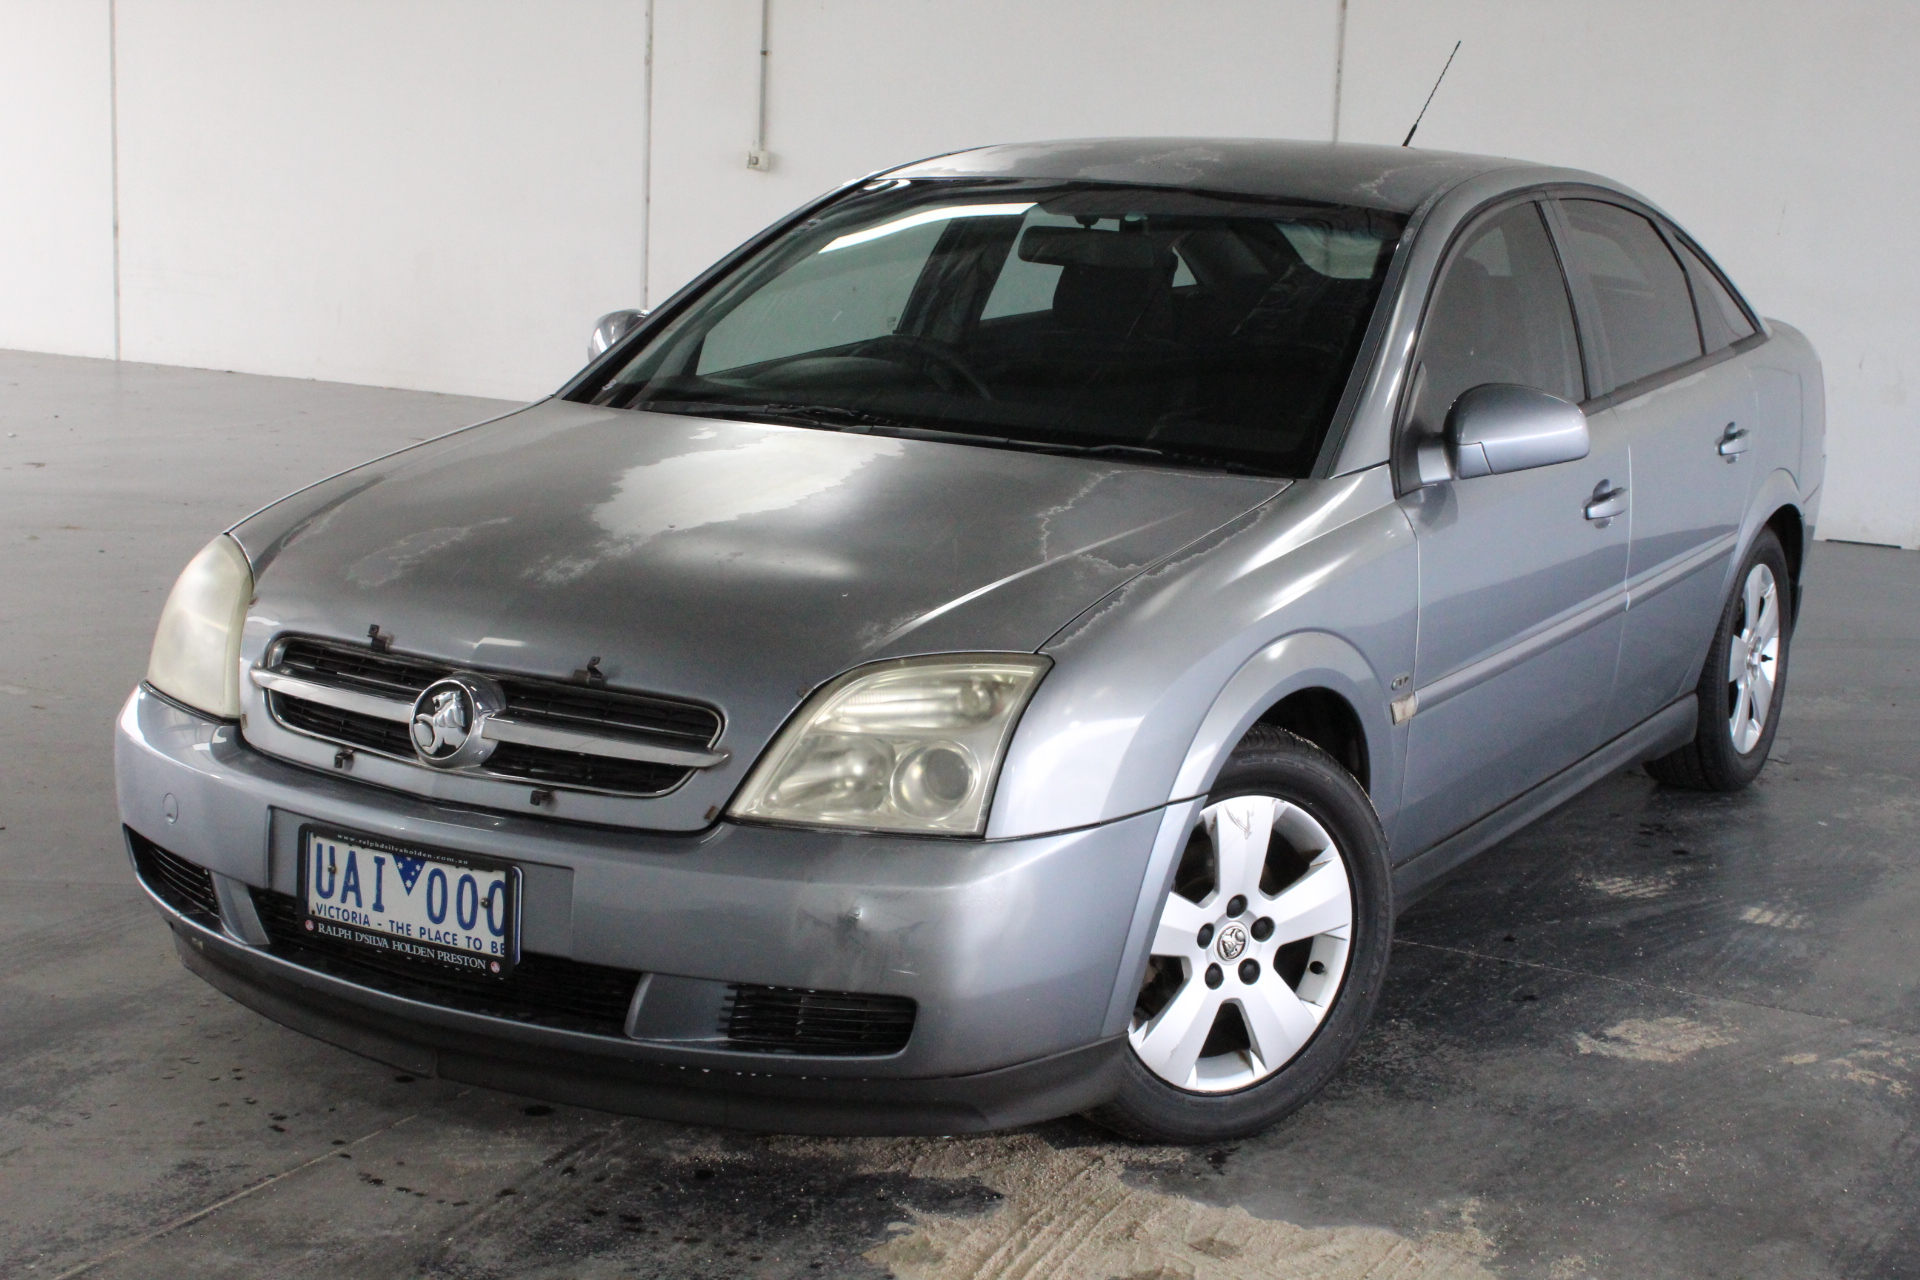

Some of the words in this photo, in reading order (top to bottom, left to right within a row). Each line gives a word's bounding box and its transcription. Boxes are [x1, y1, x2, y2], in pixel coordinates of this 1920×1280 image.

[316, 842, 385, 913] UAI
[426, 867, 505, 937] 000
[316, 903, 370, 927] VICTORIA
[389, 920, 412, 936] THE
[420, 927, 458, 946] PLACE
[466, 936, 482, 950] TO
[318, 923, 352, 940] RALPH
[355, 932, 389, 949] D'SILVA
[392, 941, 435, 959] HOLDEN
[437, 950, 486, 970] PRESTON
